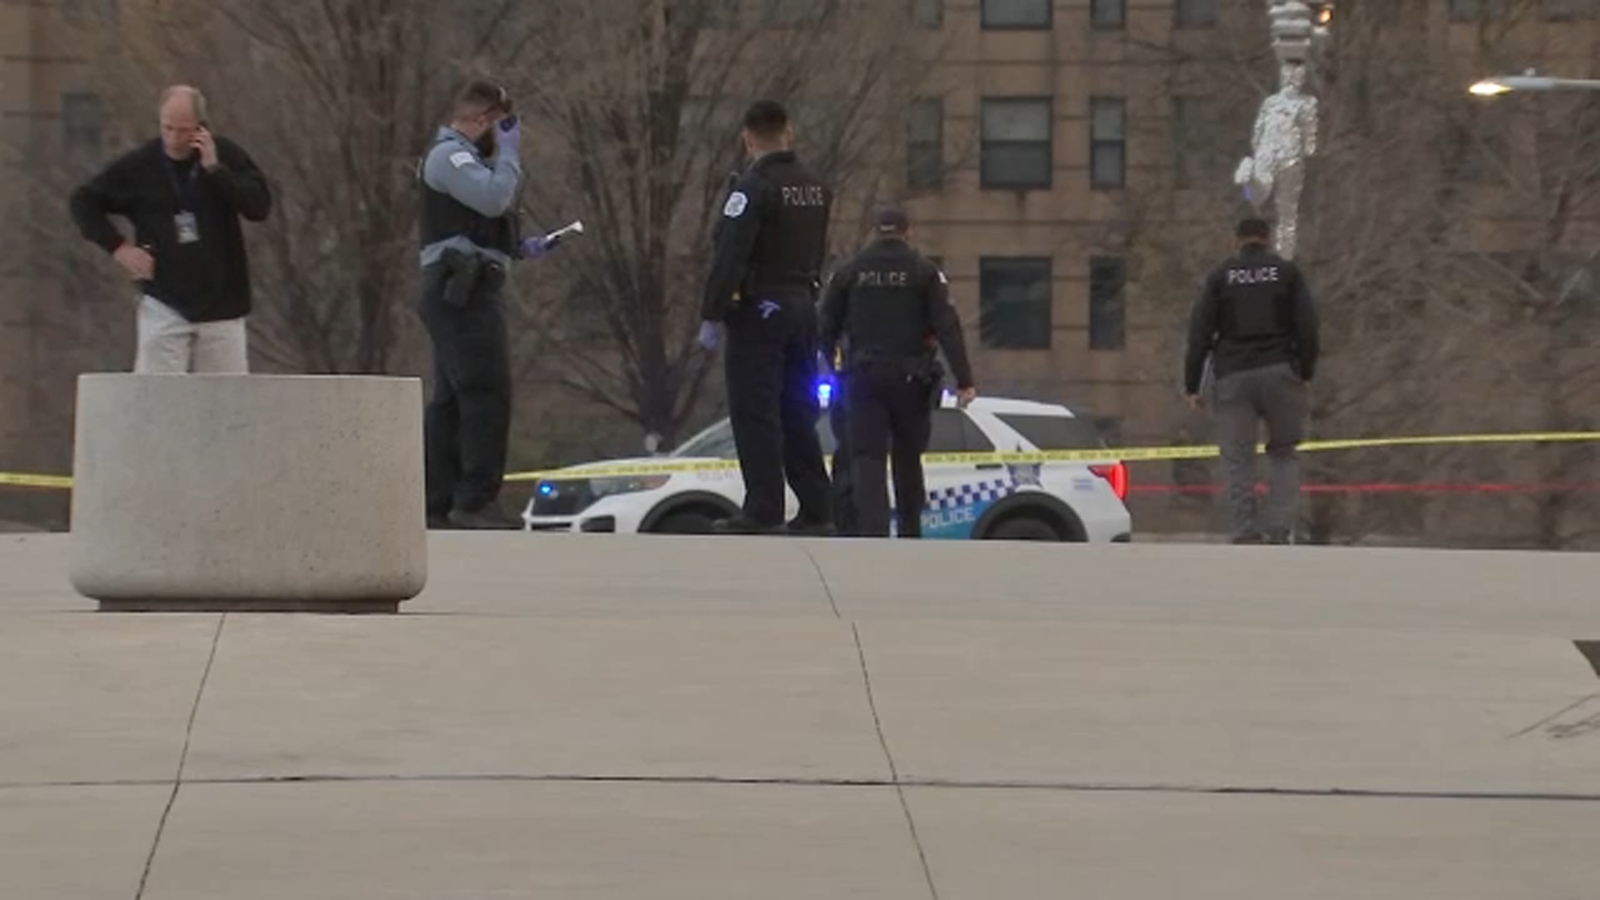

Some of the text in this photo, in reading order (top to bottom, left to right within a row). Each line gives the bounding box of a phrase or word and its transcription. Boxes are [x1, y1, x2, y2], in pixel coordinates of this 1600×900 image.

[781, 186, 824, 206] POLICE
[858, 270, 907, 287] POLICE
[1228, 266, 1279, 284] POLICE
